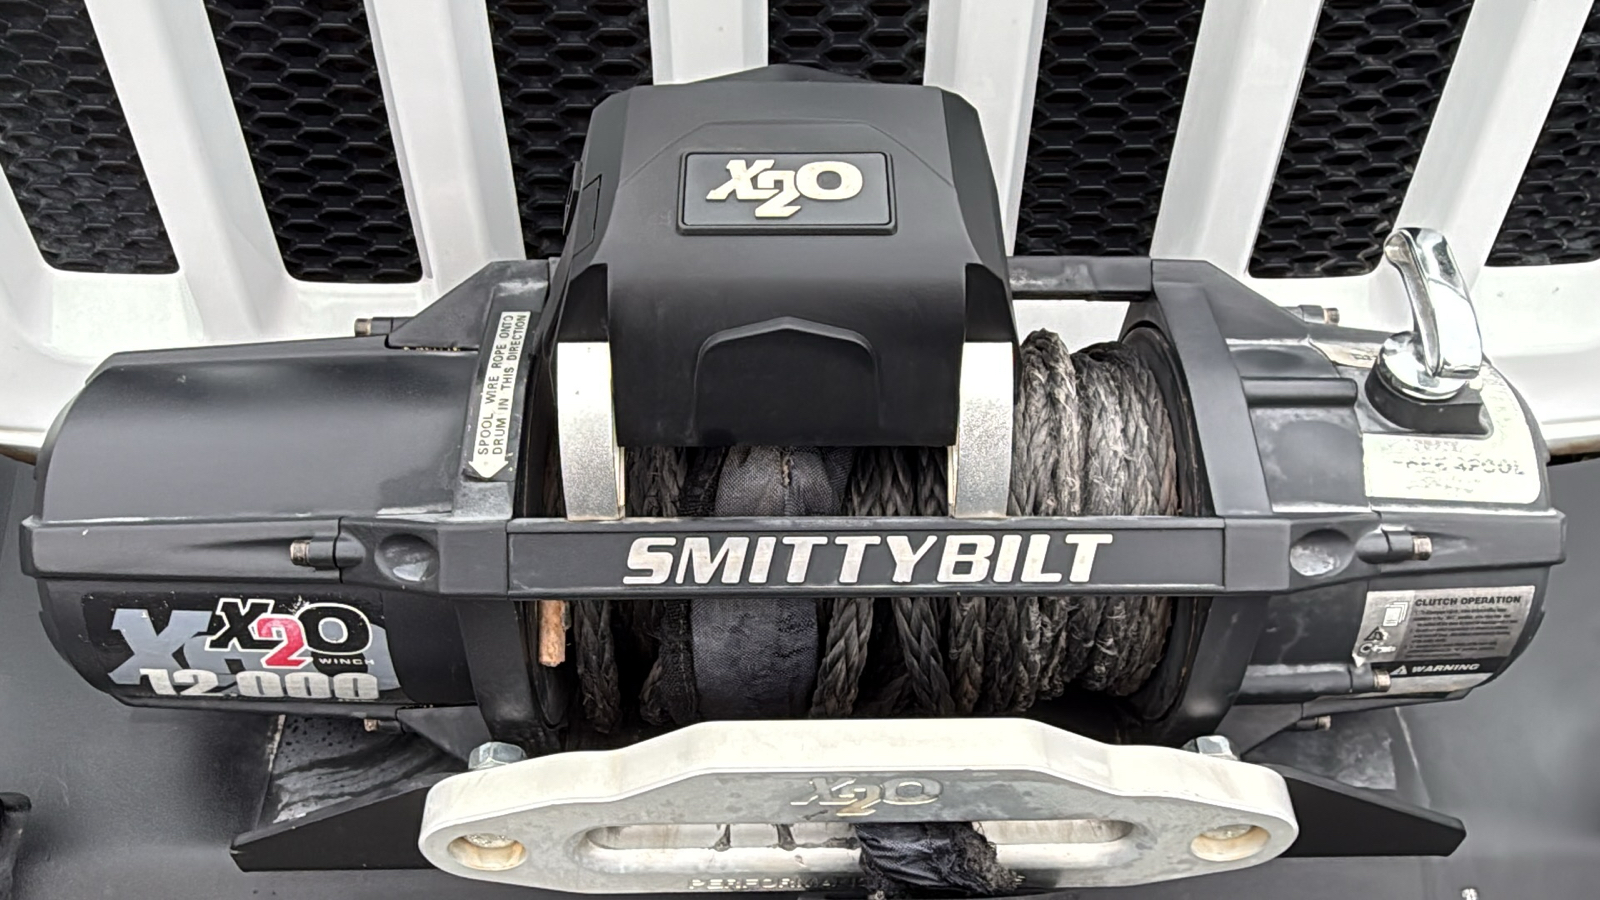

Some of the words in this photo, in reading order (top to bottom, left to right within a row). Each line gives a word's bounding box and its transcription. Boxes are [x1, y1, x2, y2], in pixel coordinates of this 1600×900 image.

[499, 315, 514, 339] ONTO
[506, 314, 527, 361] DIRECTION
[491, 344, 507, 369] ROPE
[485, 375, 500, 404] WIRE
[501, 367, 514, 391] THIS
[498, 398, 509, 410] IN
[477, 413, 494, 455] SPOOL
[492, 418, 507, 455] DRUM
[622, 534, 1114, 585] SMITTYBILT
[1415, 598, 1458, 607] CLUTCH
[1460, 596, 1522, 605] OPERATION
[318, 656, 376, 666] WINCH
[1411, 663, 1481, 674] WARNING
